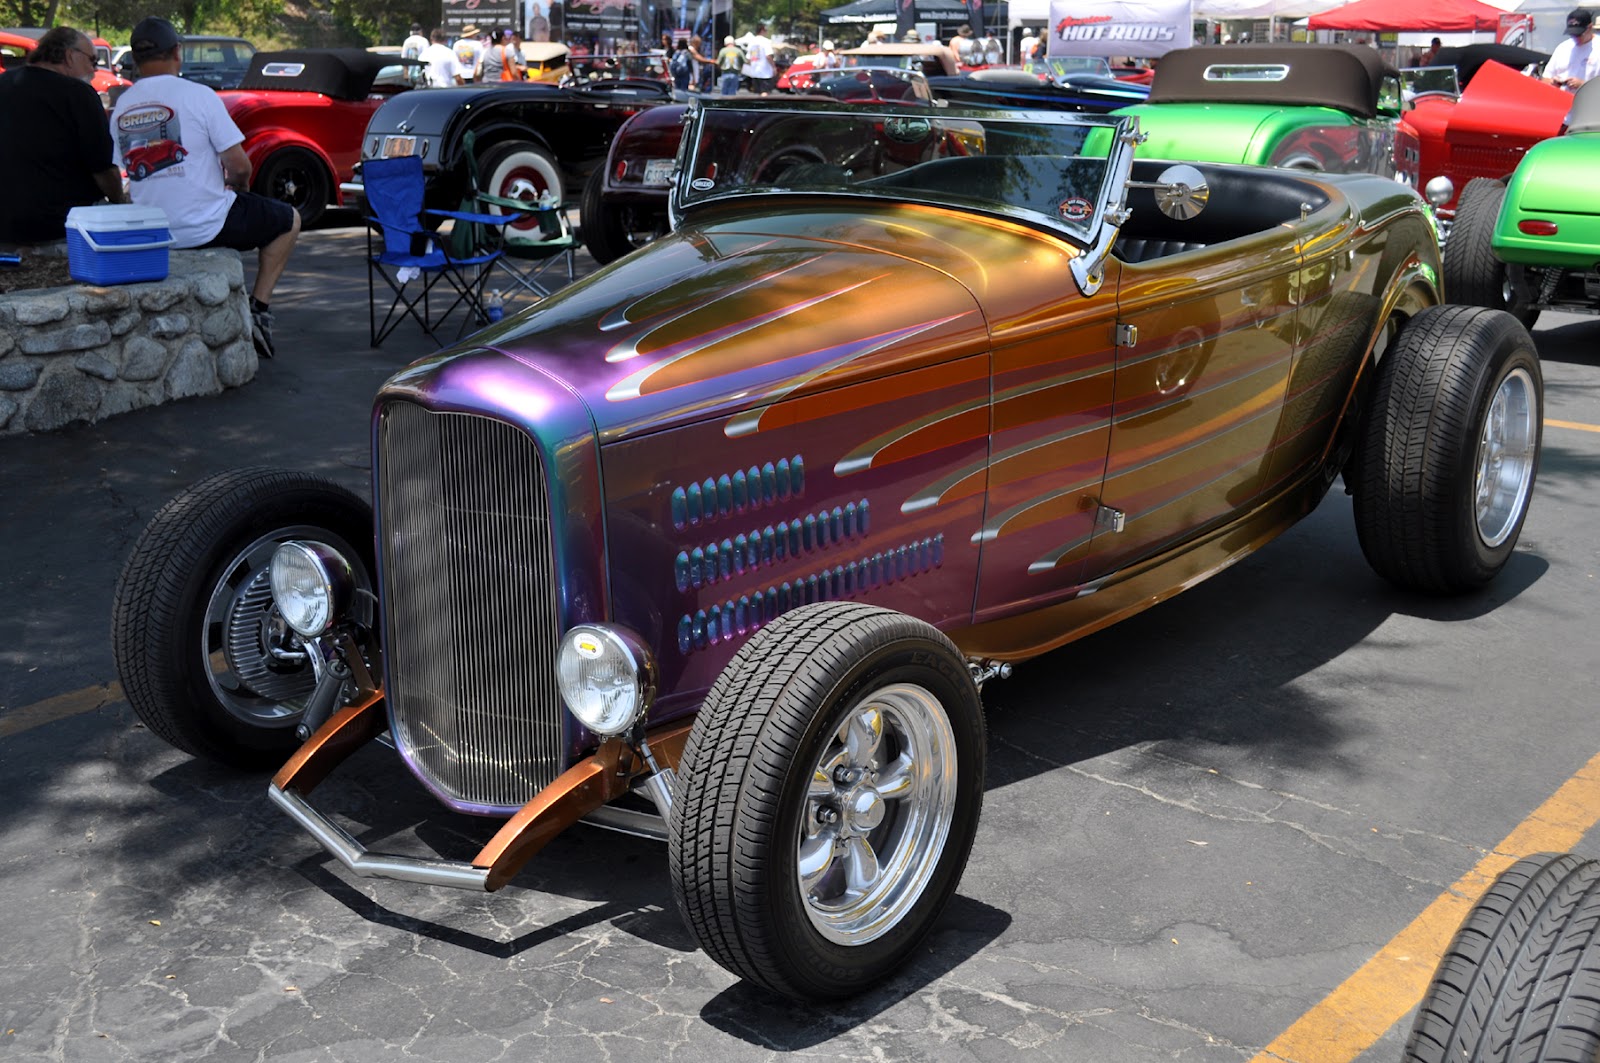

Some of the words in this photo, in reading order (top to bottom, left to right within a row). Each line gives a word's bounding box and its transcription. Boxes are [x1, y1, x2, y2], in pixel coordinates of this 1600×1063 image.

[1059, 24, 1105, 41] HOT
[1106, 24, 1178, 41] RODS
[121, 111, 167, 128] BRIZIO
